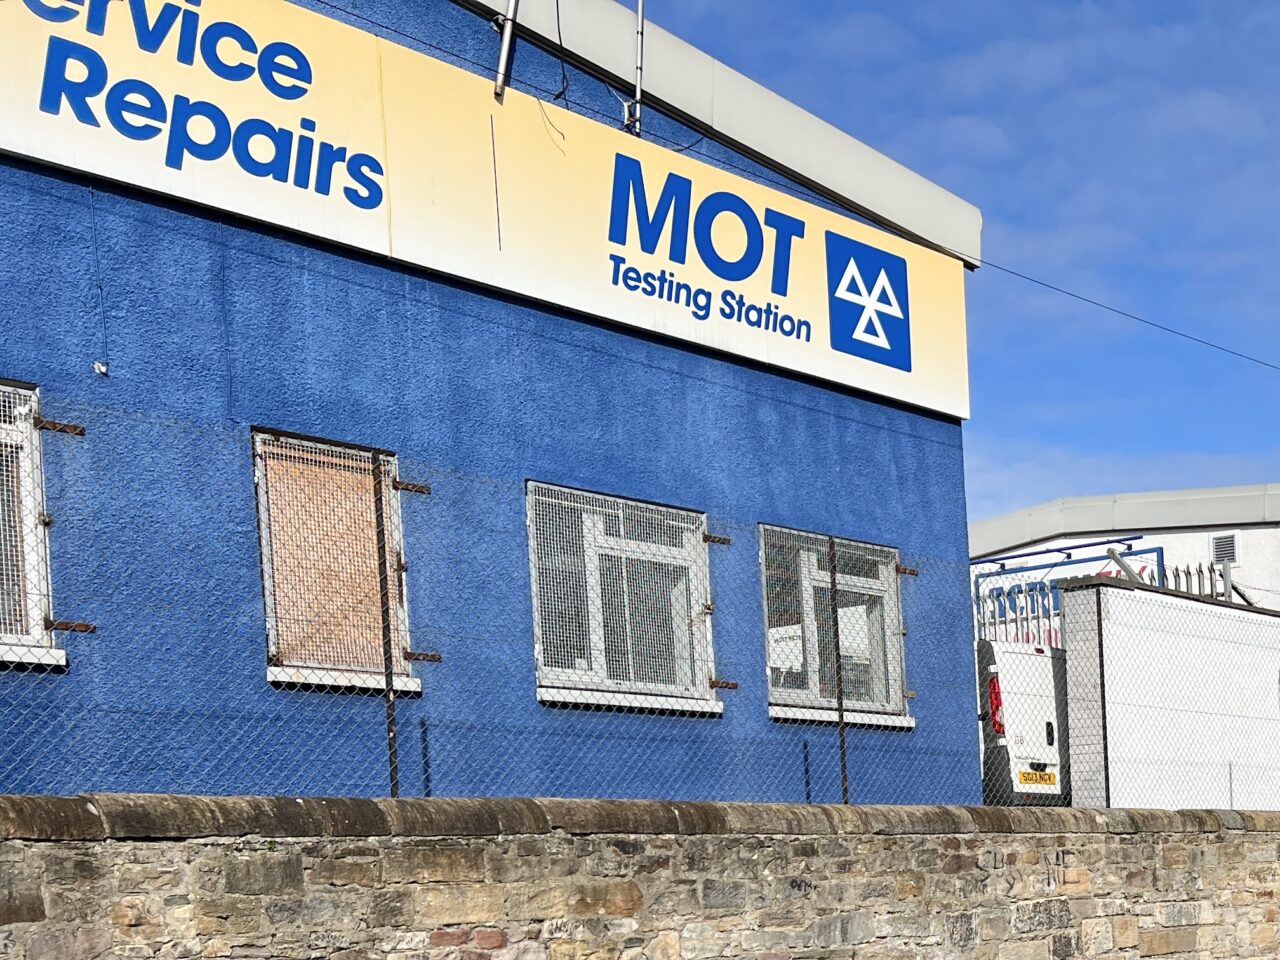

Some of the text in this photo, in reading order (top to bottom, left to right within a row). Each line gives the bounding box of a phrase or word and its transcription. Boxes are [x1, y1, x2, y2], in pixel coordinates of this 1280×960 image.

[39, 35, 384, 210] Repairs
[608, 152, 806, 297] MOT
[609, 253, 811, 342] Testing Station
